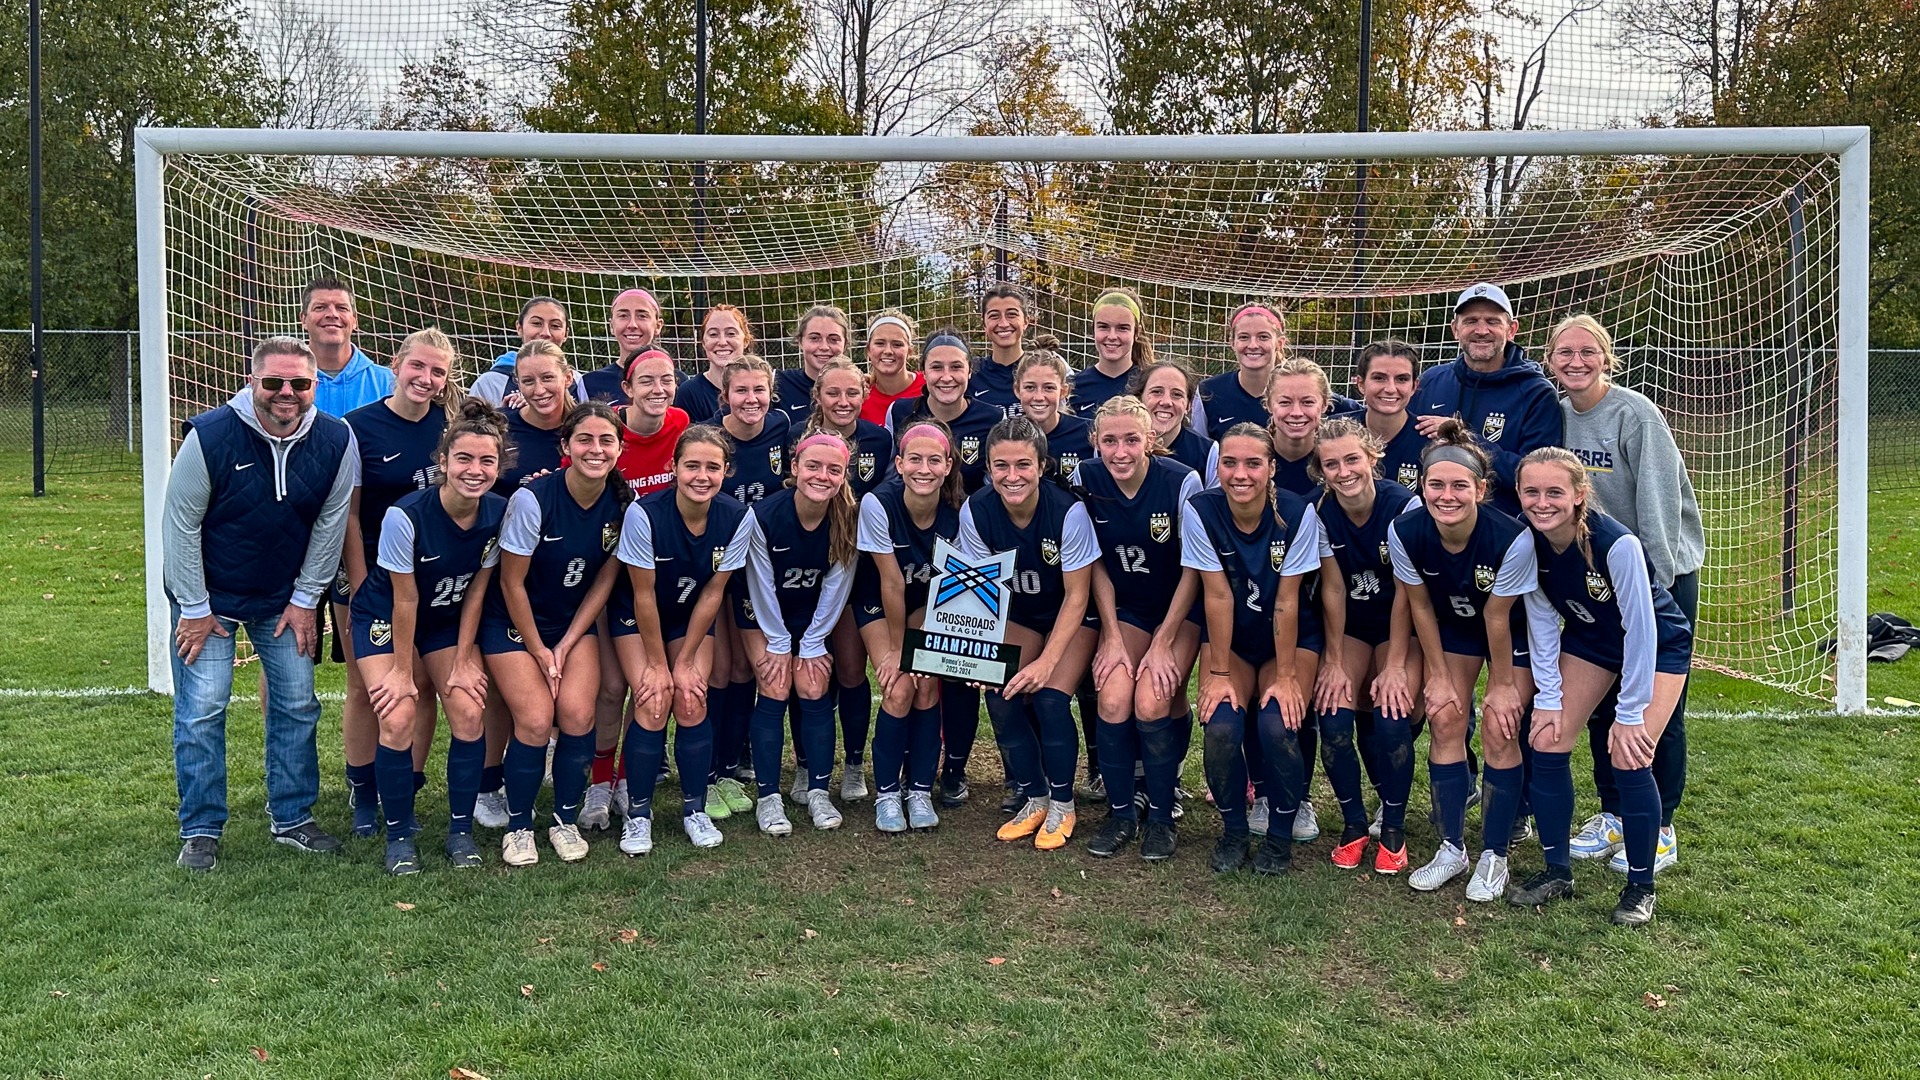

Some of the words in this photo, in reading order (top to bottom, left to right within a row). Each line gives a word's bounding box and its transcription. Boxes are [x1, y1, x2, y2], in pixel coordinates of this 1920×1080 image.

[962, 440, 978, 449] SAU
[647, 472, 674, 486] ARBO
[1400, 469, 1417, 478] SAU
[1152, 519, 1169, 528] SAU
[1115, 545, 1150, 574] 12
[563, 558, 586, 587] 8
[782, 568, 821, 588] 23
[903, 563, 930, 584] 14
[1013, 570, 1041, 594] 10
[431, 573, 474, 607] 25
[677, 577, 697, 603] 7
[1246, 578, 1262, 612] 2
[1350, 570, 1380, 600] 24
[1449, 595, 1476, 617] 5
[1565, 599, 1595, 623] 9
[936, 611, 996, 631] CROSSROADS
[945, 625, 984, 637] LEAGUE
[925, 634, 999, 659] CHAMPIONS
